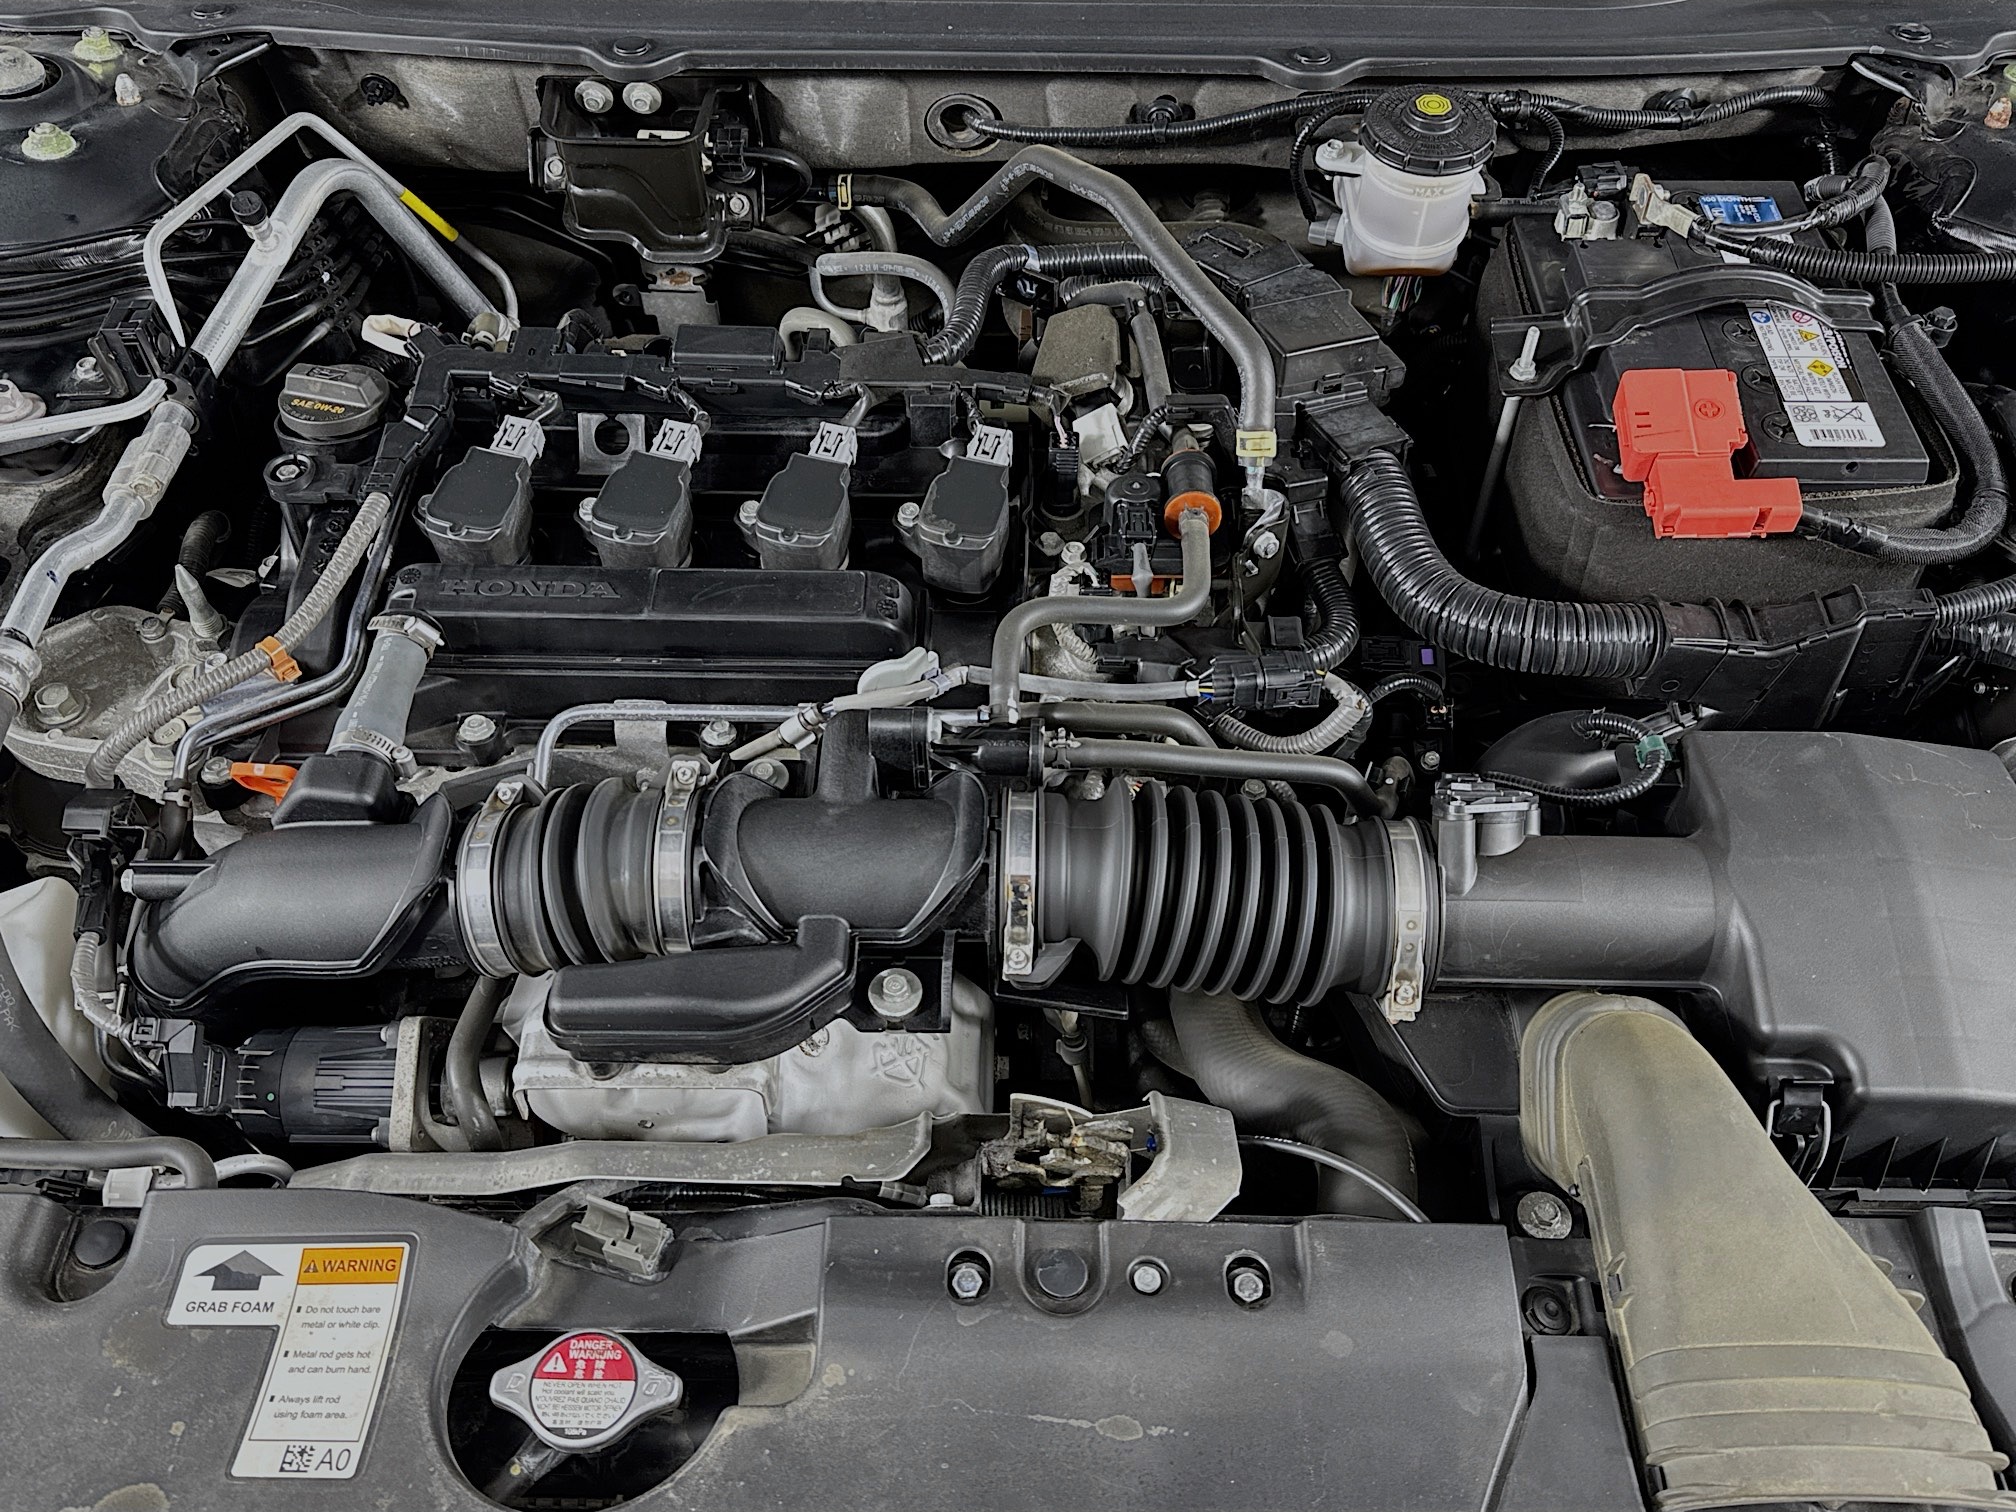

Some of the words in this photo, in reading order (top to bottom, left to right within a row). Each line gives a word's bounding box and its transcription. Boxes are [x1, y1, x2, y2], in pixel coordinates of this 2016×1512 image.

[1414, 188, 1445, 198] MAX
[291, 398, 314, 409] SAE
[314, 403, 346, 414] 0W-20
[440, 580, 621, 598] HONDA
[322, 1259, 397, 1273] WARNING
[186, 1302, 228, 1313] GRAB
[232, 1302, 275, 1312] FOAM
[363, 1321, 380, 1330] clip.
[570, 1339, 614, 1350] DANGER
[335, 1351, 354, 1360] gets
[569, 1350, 622, 1360] WARNING
[278, 1395, 310, 1405] Always
[312, 1395, 324, 1404] lift
[325, 1396, 341, 1404] rod
[274, 1411, 298, 1420] using
[300, 1411, 323, 1419] foam
[315, 1448, 352, 1471] A0
